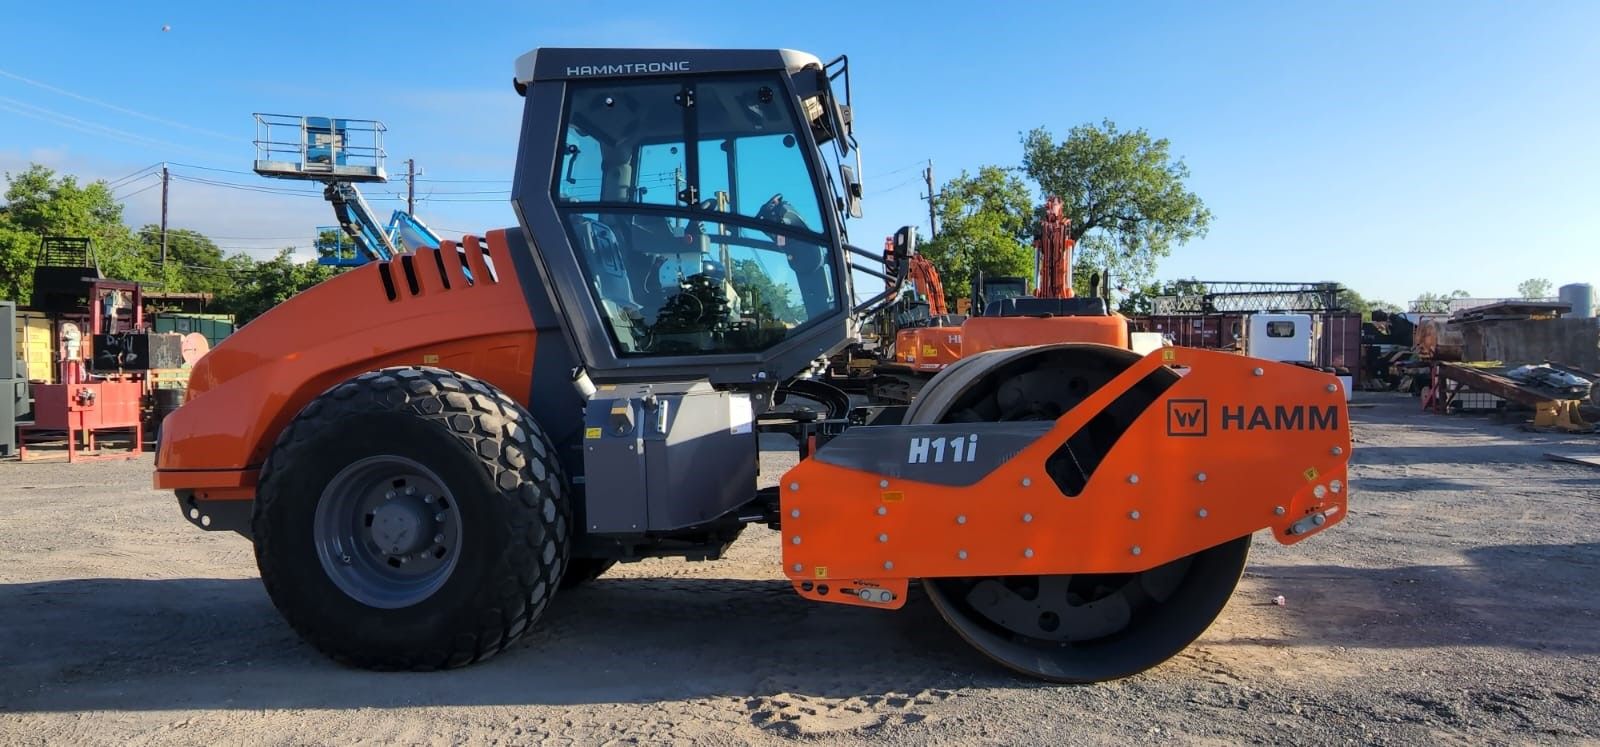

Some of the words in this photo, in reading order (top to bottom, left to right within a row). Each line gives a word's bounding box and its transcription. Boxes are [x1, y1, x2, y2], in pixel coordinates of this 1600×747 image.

[566, 61, 690, 76] HAMMTRONIC
[1221, 405, 1338, 430] HAMM
[908, 433, 978, 464] H11i
